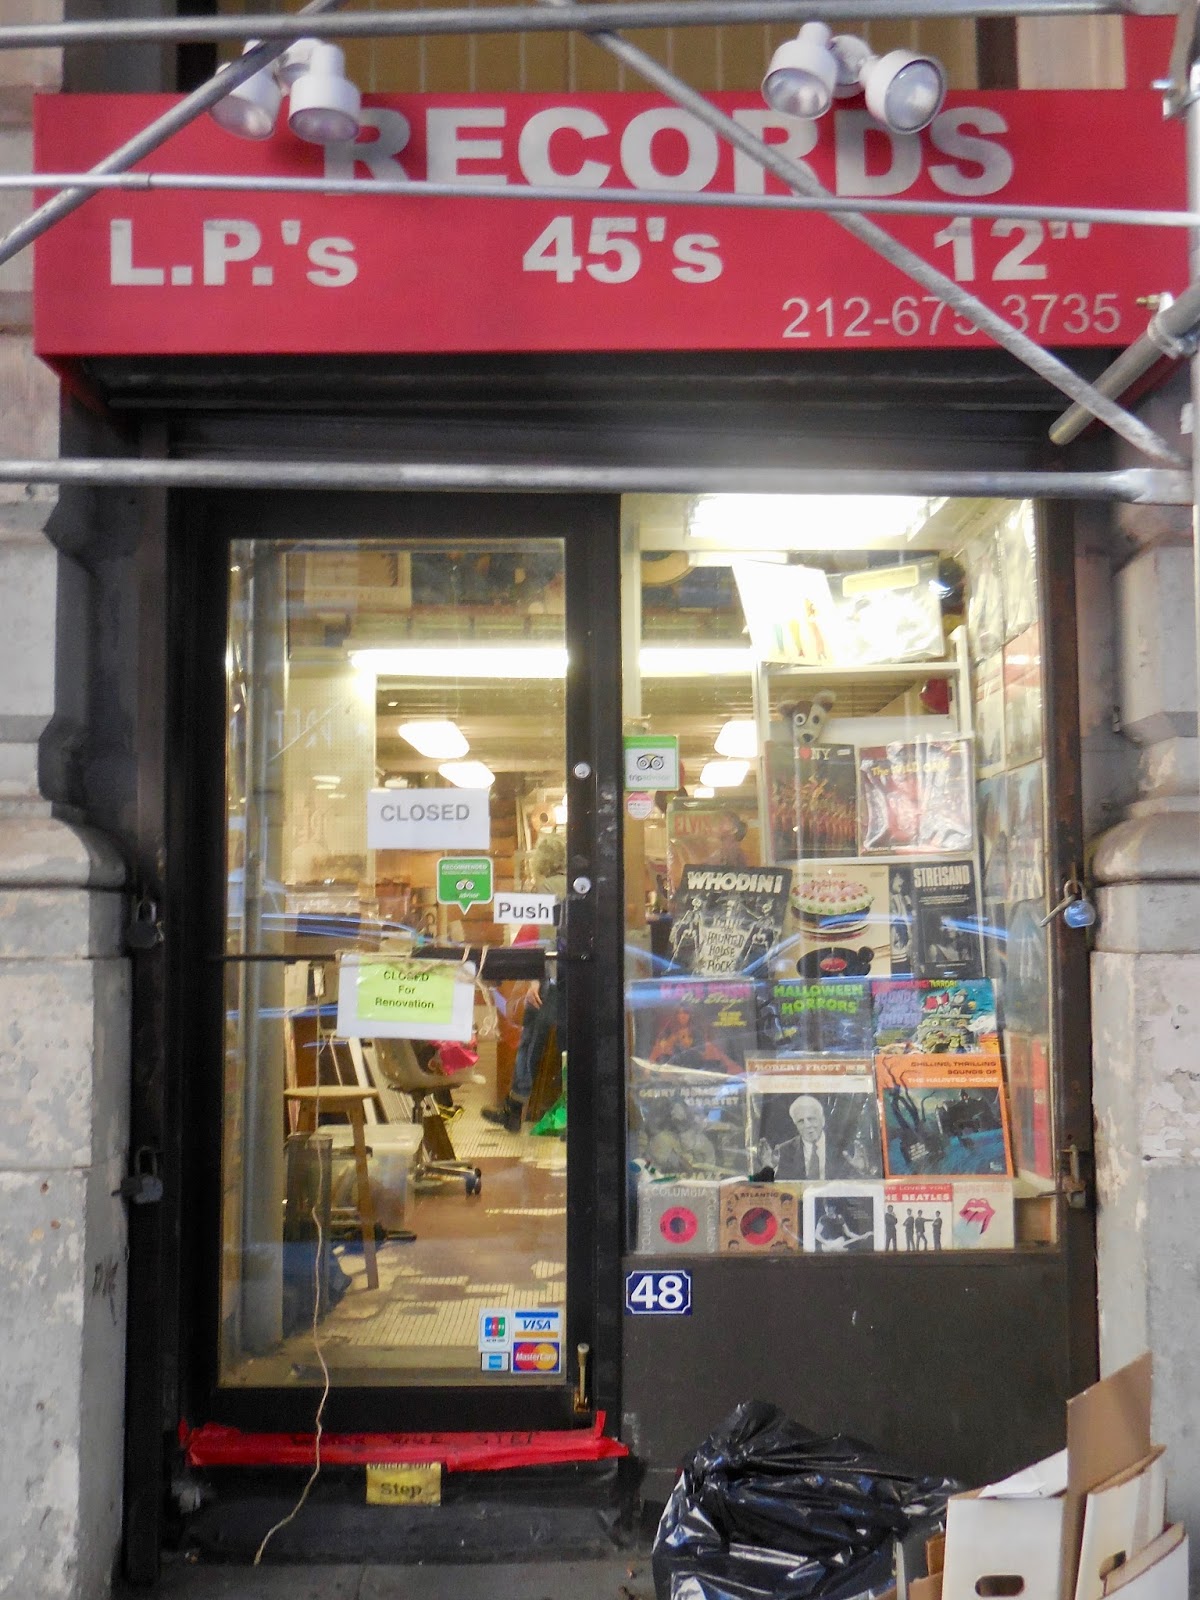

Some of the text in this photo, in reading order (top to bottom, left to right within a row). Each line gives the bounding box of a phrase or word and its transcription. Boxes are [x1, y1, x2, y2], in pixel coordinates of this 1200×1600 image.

[323, 106, 1014, 197] RECORDS
[110, 219, 358, 287] L.P.'s
[522, 217, 723, 284] 45's
[782, 293, 1121, 340] 212-6753735
[380, 803, 470, 823] CLOSED
[687, 871, 783, 893] WHODINI
[913, 865, 970, 888] STREISAND
[498, 903, 549, 919] Push
[398, 985, 416, 995] For
[774, 984, 864, 997] HALLOWEEN
[375, 997, 435, 1009] Renovation
[781, 998, 857, 1014] HORRORS
[805, 1063, 841, 1072] FROST
[653, 1186, 707, 1198] COLUMBIA
[739, 1191, 779, 1199] ATLANTIC
[901, 1193, 950, 1201] BEATLES
[631, 1275, 684, 1308] 48
[523, 1319, 551, 1331] VISA
[515, 1352, 557, 1362] MasterCard
[380, 1482, 422, 1499] Step
